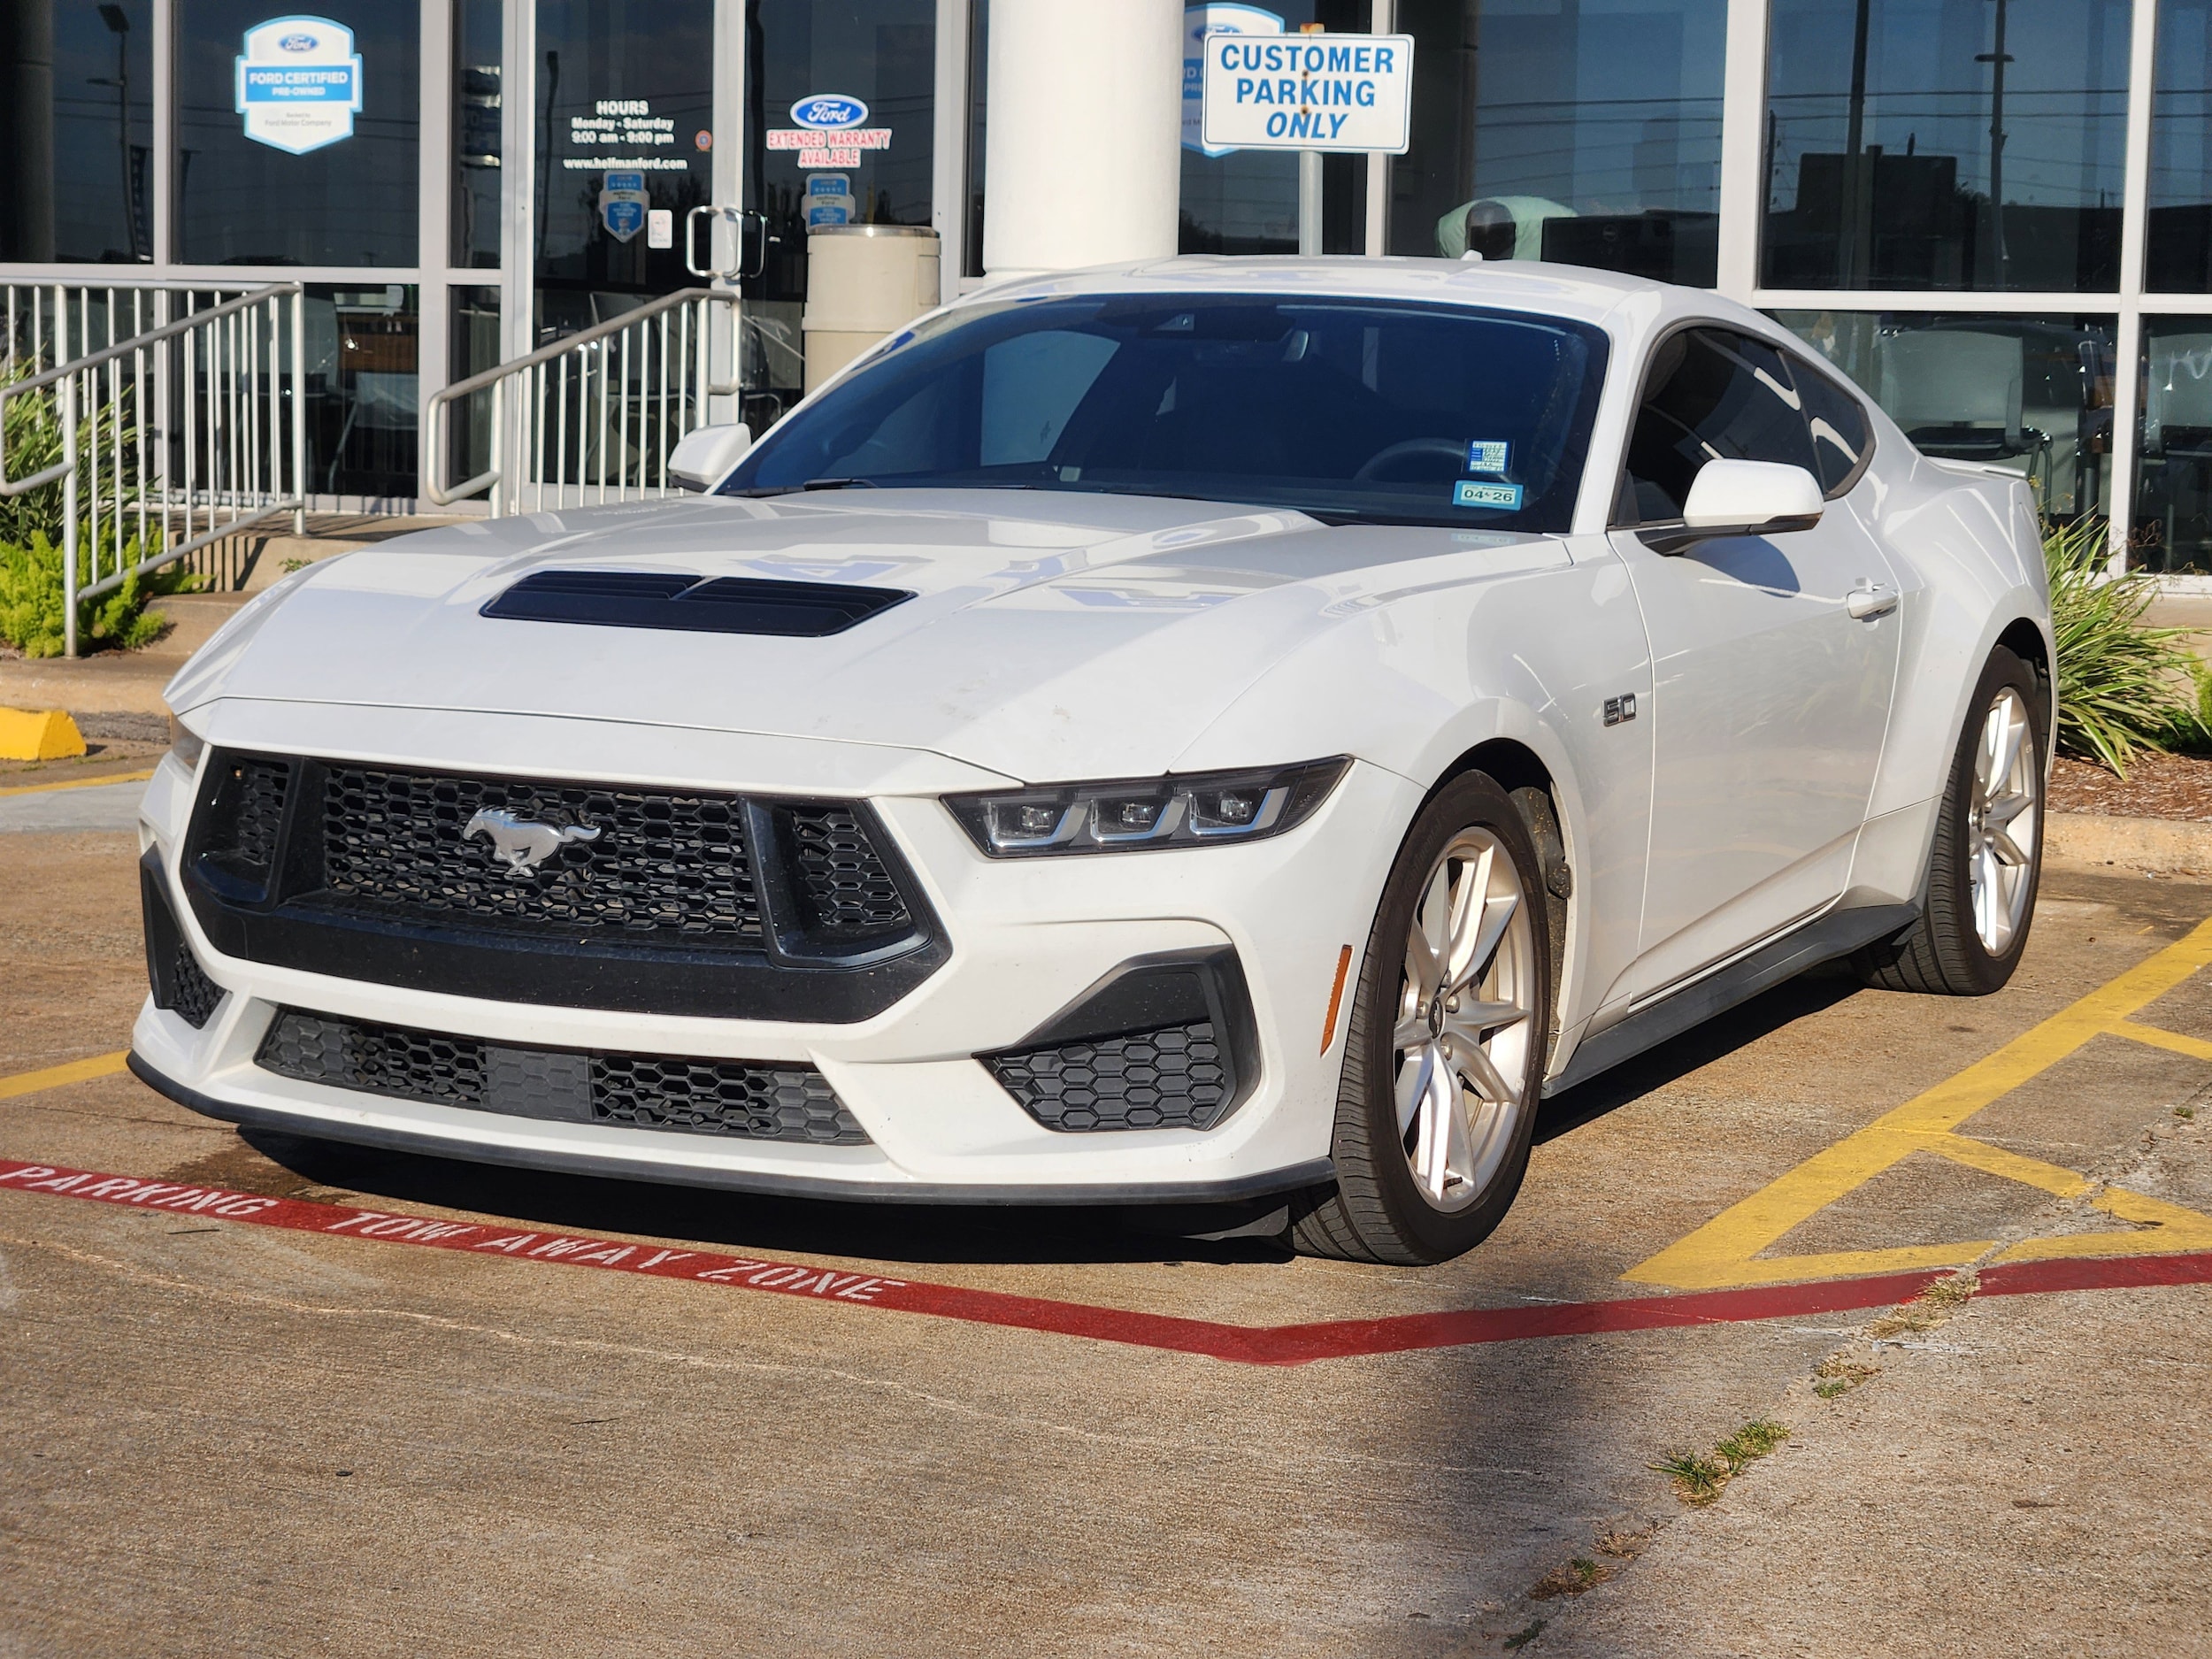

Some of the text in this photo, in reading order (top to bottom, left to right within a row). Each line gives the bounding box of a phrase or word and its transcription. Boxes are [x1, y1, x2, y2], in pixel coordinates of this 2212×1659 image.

[1220, 43, 1394, 74] CUSTOMER
[250, 71, 349, 85] FORD CERTIFIED
[1236, 78, 1375, 107] PARKING
[595, 100, 649, 116] HOURS
[806, 100, 852, 123] Ford
[571, 117, 616, 132] Monday
[622, 117, 674, 132] Saturday
[1265, 111, 1349, 139] ONLY
[571, 130, 597, 143] 9:00
[598, 133, 618, 143] am
[626, 131, 654, 143] 9:00
[655, 133, 675, 146] pm
[767, 129, 892, 149] EXTENDED WARRANTY
[798, 149, 860, 167] AVAILABLE
[1463, 489, 1484, 499] 04
[1493, 492, 1513, 502] 26
[0, 1165, 910, 1302] PARKING TOW AWAY ZONE
